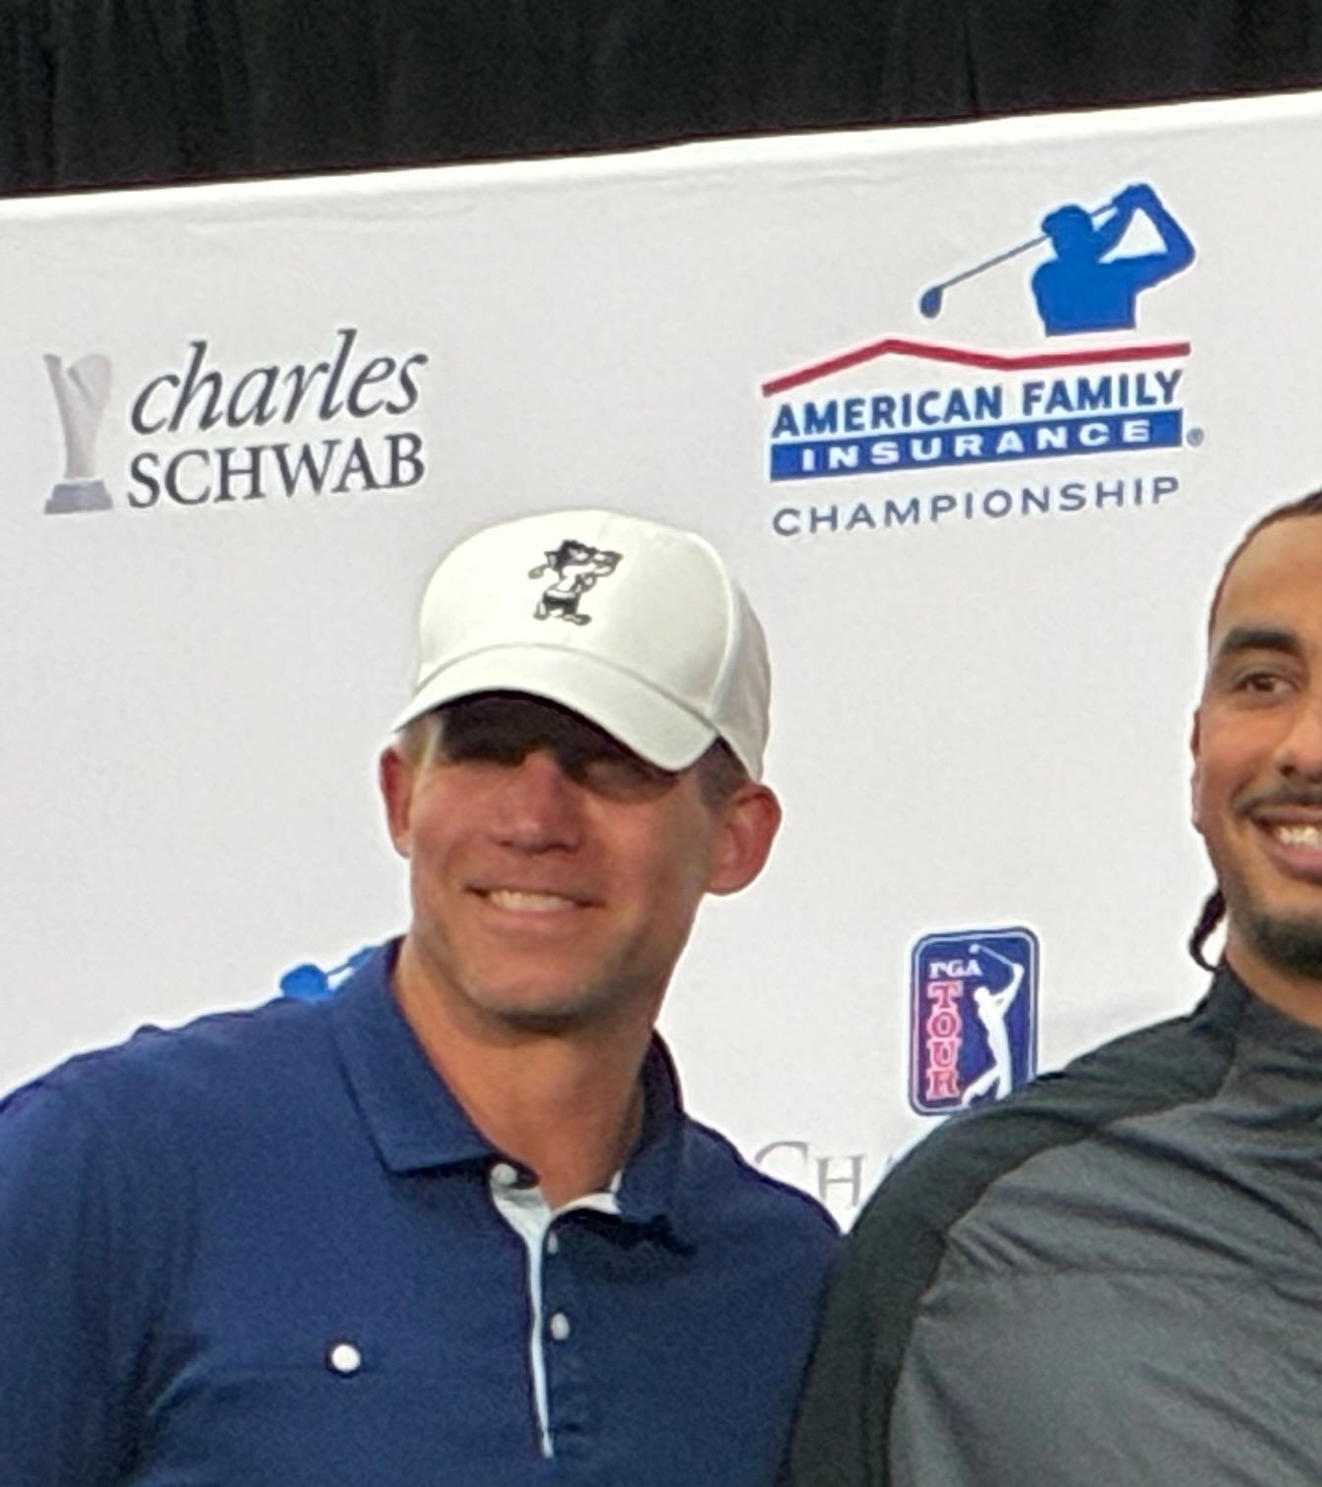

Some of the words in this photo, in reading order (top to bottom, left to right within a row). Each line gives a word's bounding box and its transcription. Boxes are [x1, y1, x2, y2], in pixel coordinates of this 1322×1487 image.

[129, 327, 429, 436] charles
[771, 385, 1002, 440] AMERICAN
[1022, 369, 1183, 418] FAMILY
[127, 432, 427, 510] SCHWAB
[801, 420, 1152, 472] INSURANCE
[771, 475, 1180, 537] CHAMPIONSHIP
[928, 958, 983, 979] PGA
[926, 980, 963, 1101] TOUR
